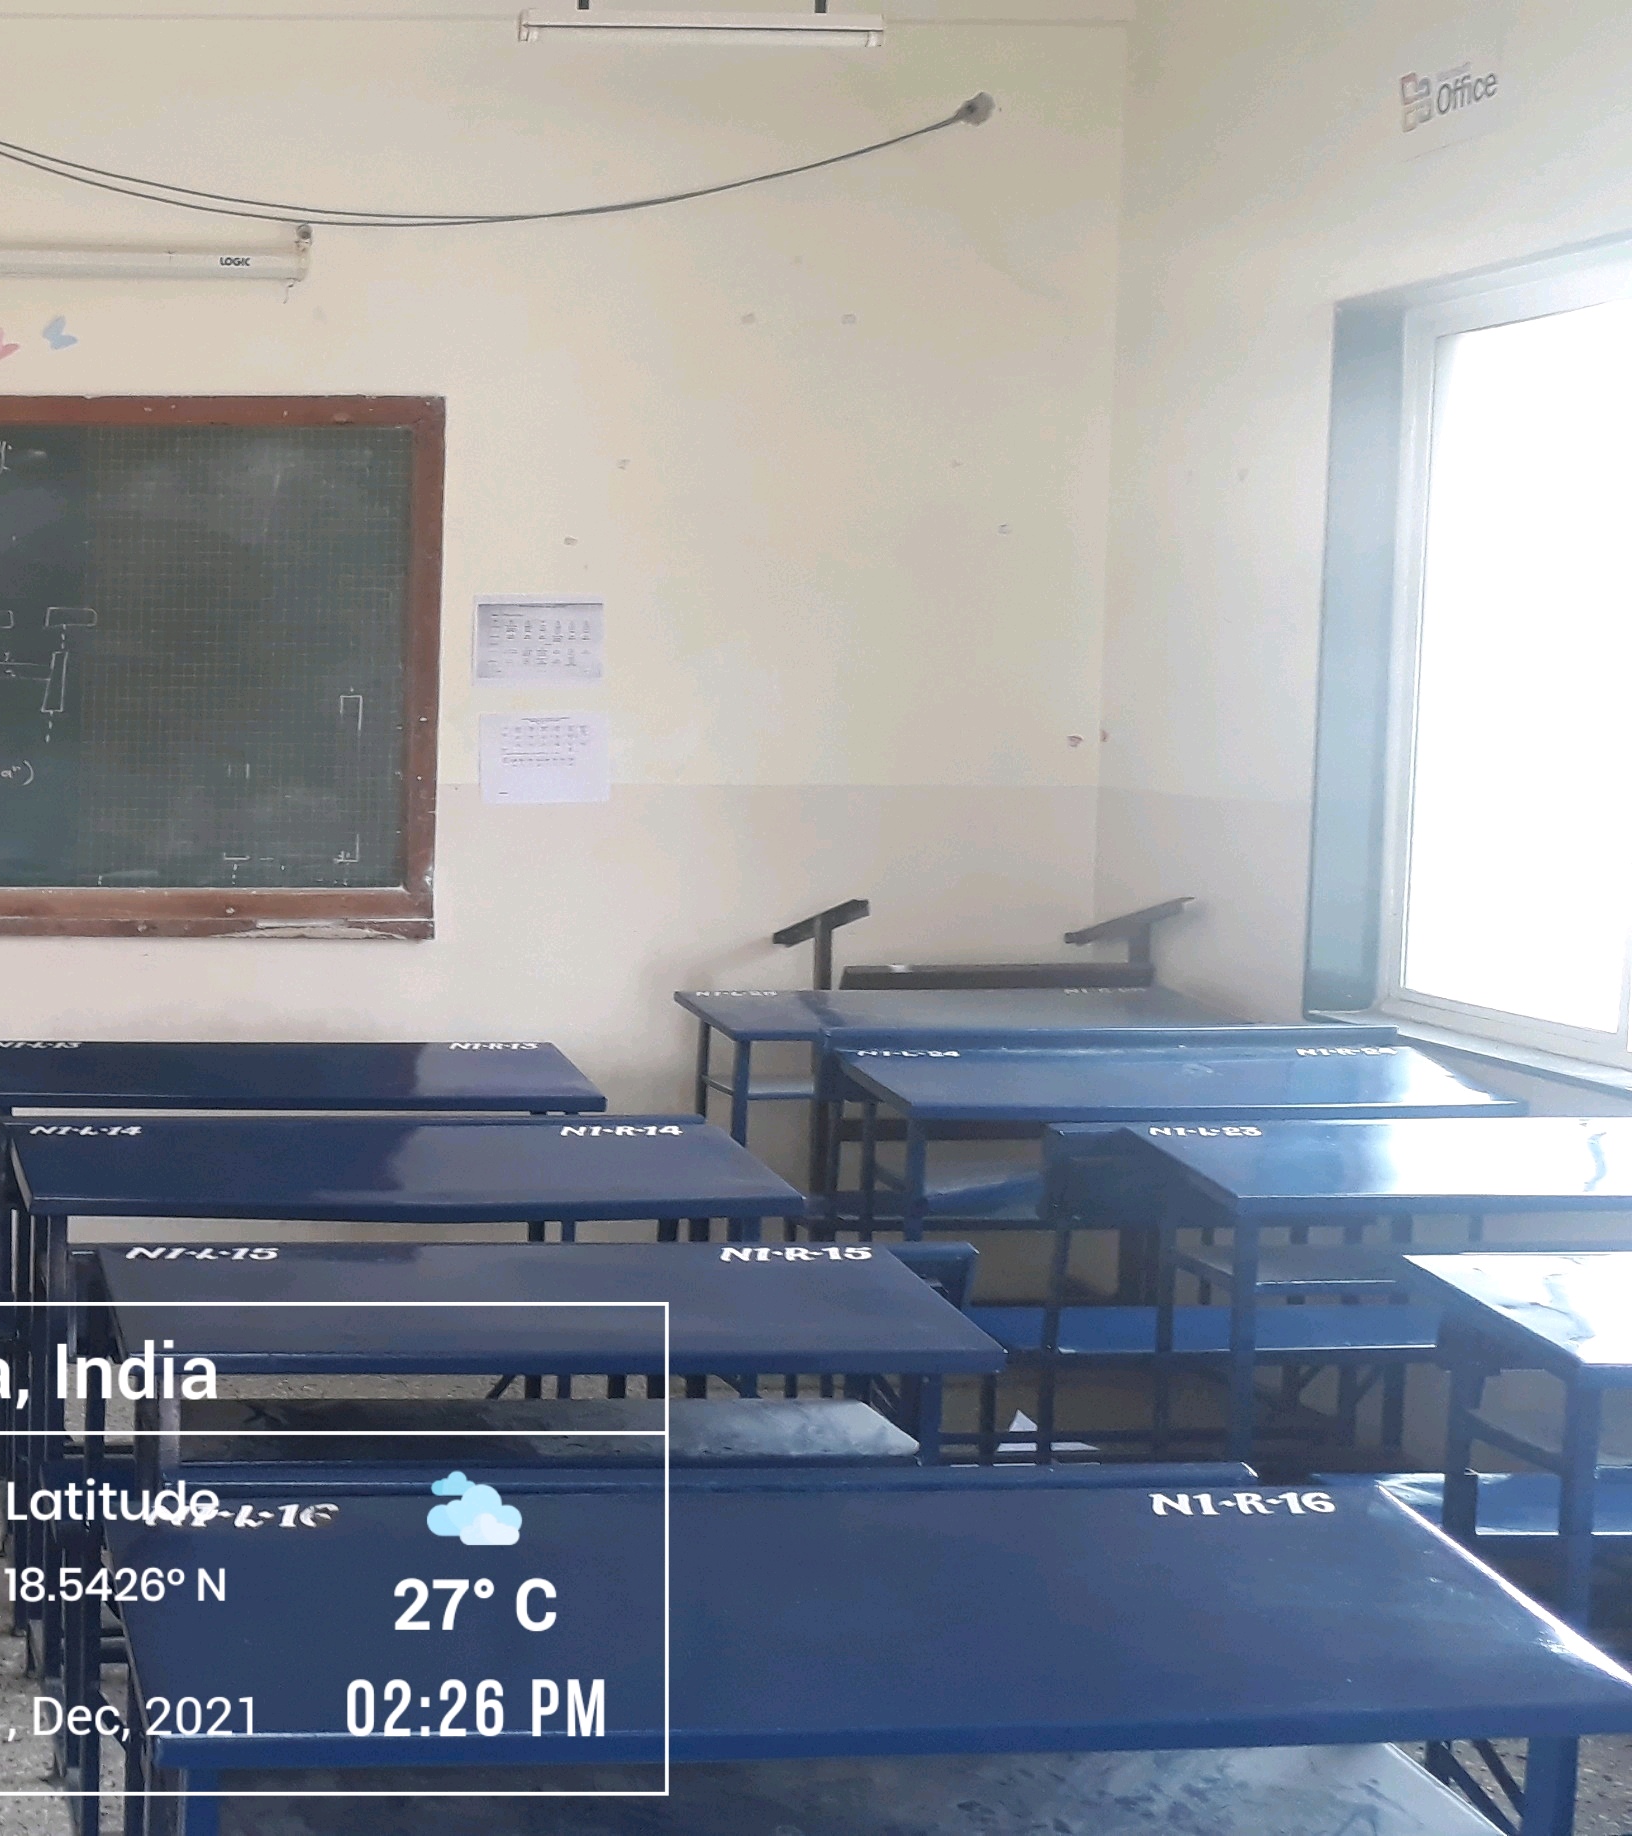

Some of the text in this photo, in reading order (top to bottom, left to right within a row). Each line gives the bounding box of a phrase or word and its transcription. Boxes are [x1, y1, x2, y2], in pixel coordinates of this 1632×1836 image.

[1437, 72, 1499, 115] Office
[219, 256, 251, 267] LOGIC
[1149, 1492, 1337, 1516] N1-R-16
